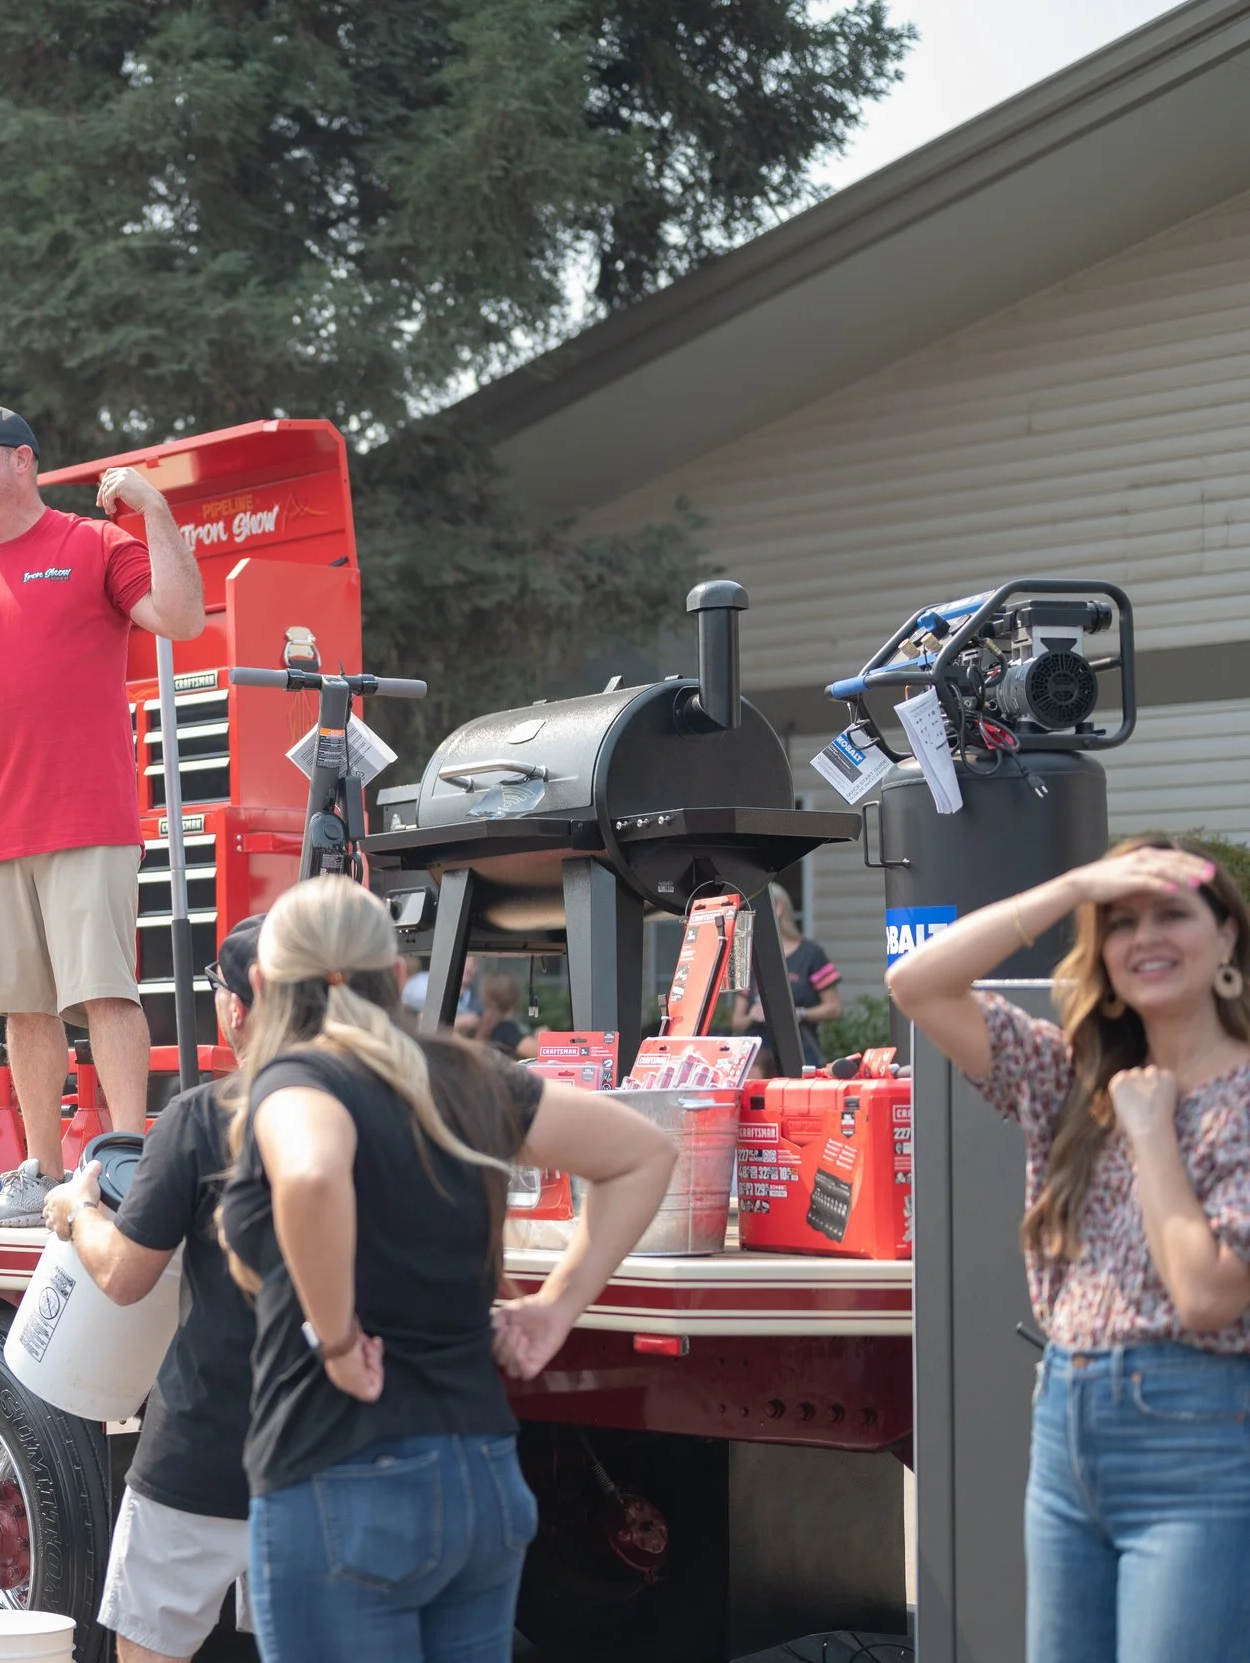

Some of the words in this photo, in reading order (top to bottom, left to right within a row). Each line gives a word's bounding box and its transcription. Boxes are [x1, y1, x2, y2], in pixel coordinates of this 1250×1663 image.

[202, 494, 255, 519] PIPELINE
[180, 520, 229, 551] Iron
[232, 503, 280, 543] Show
[23, 572, 44, 583] Iron
[44, 567, 72, 579] Show
[174, 674, 215, 690] CRAFTSMAN
[836, 736, 864, 763] KOBALT
[161, 819, 202, 833] CSMAN
[542, 1048, 578, 1056] CRAFTSMAN
[739, 1127, 776, 1139] CRAFTSMAN
